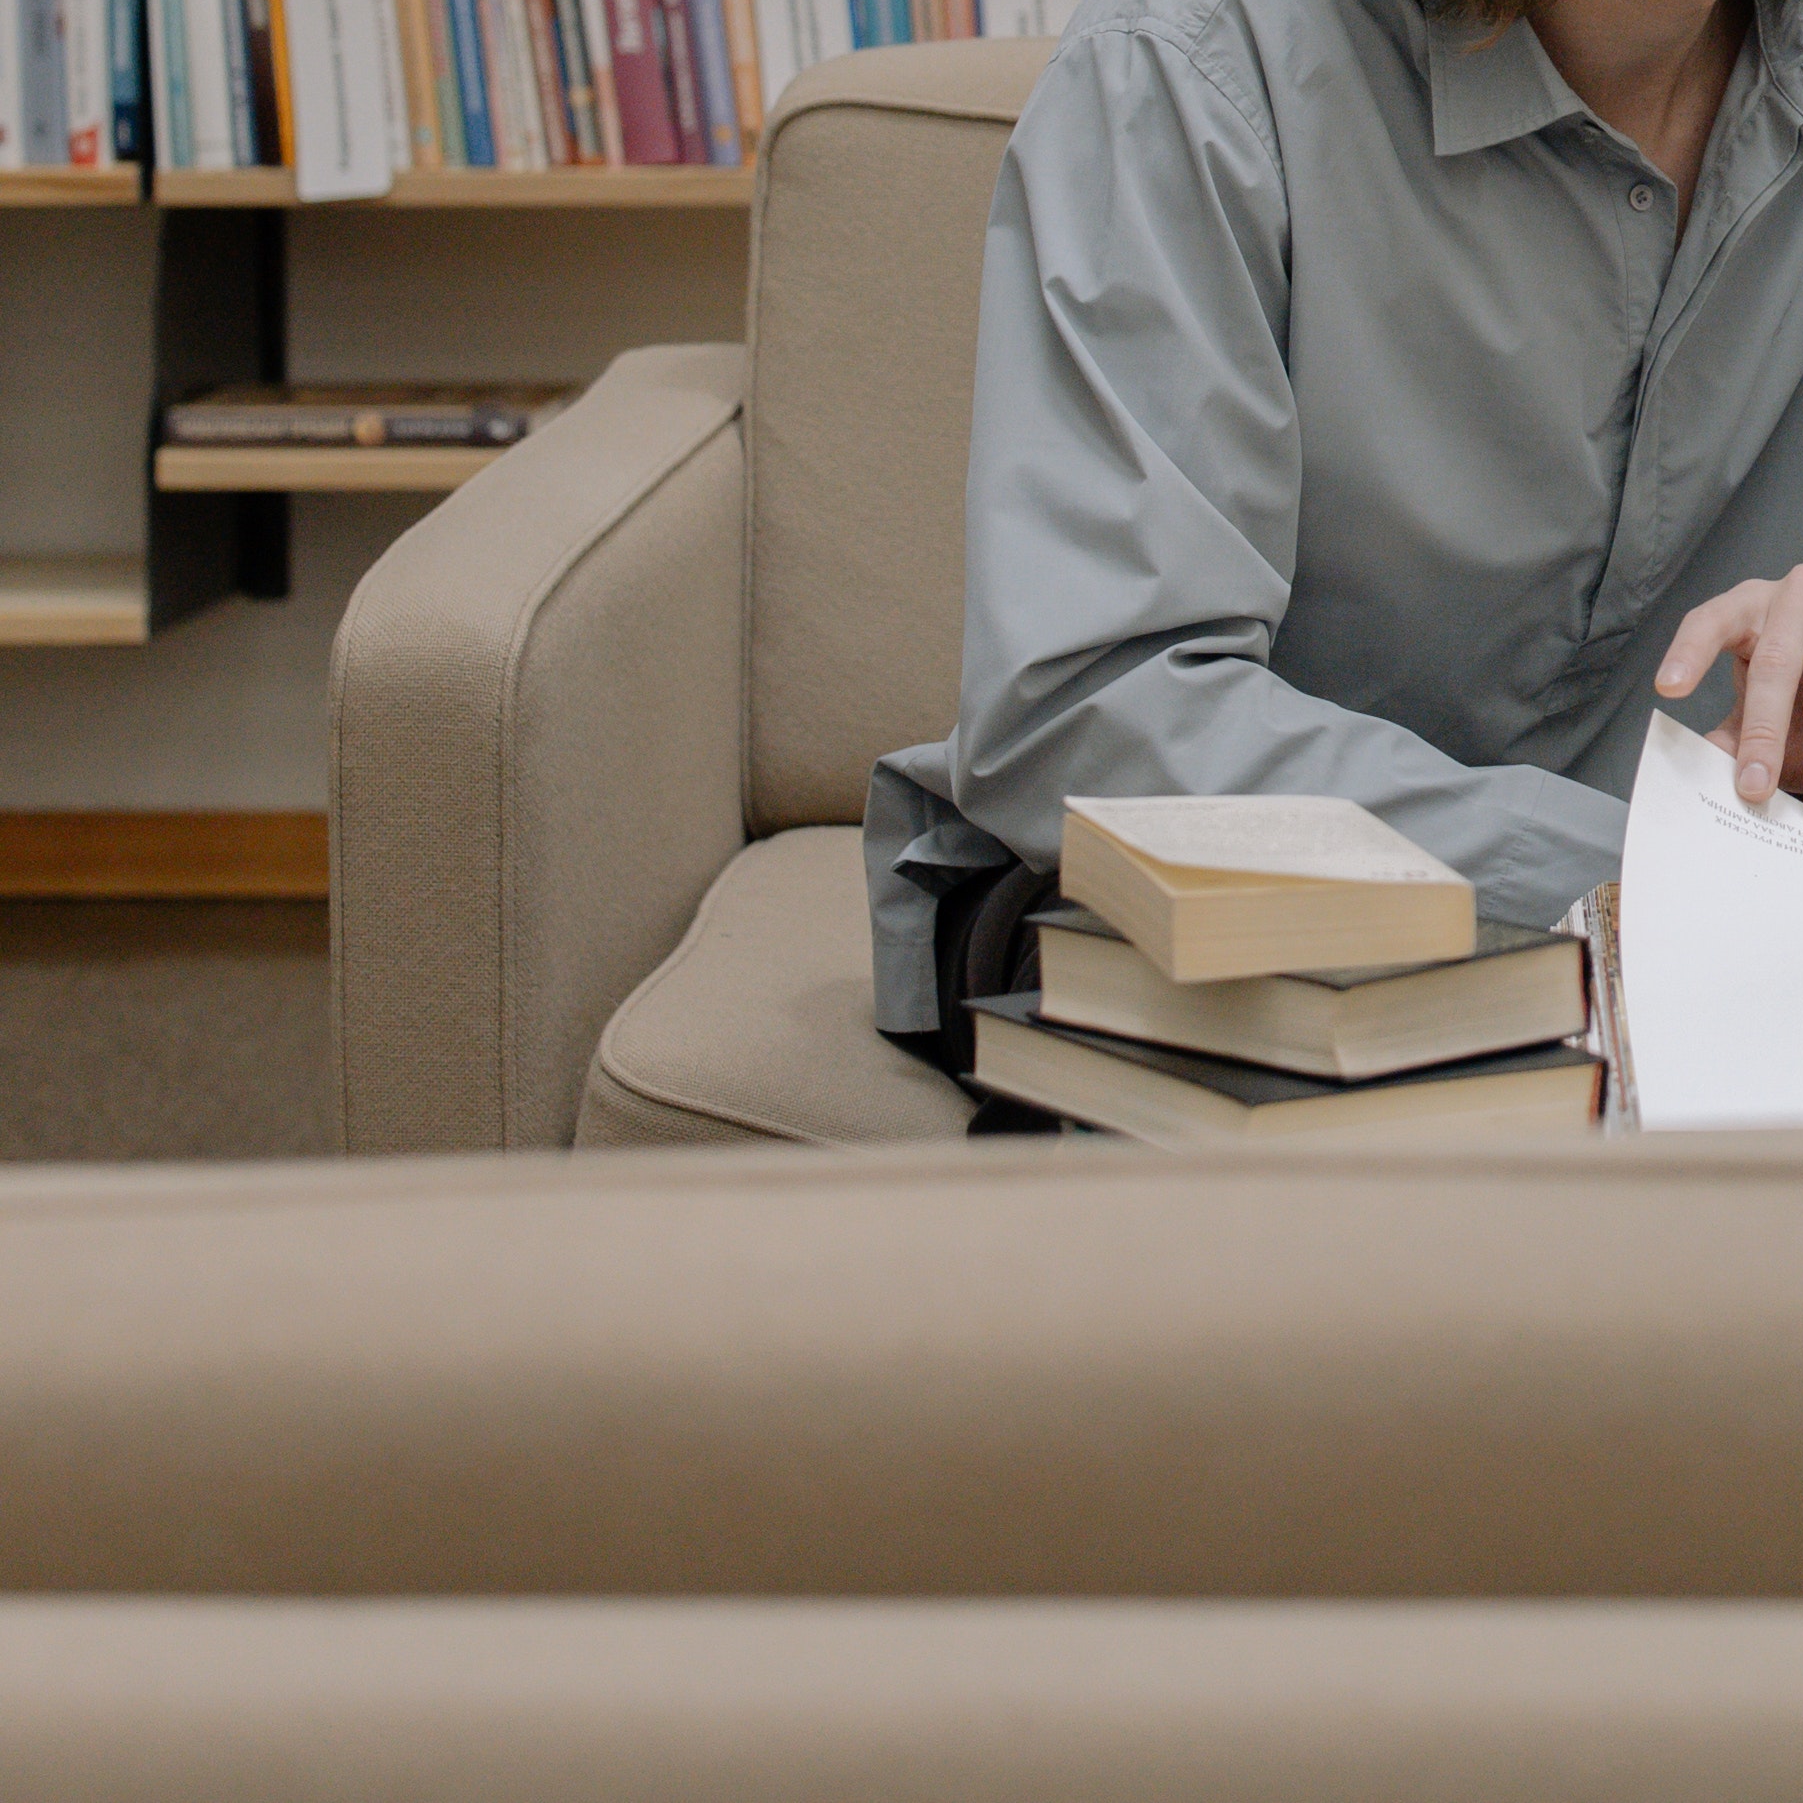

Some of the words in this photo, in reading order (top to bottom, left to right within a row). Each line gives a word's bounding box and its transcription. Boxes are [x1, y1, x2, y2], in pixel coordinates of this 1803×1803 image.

[1714, 814, 1774, 846] РУССКИХ
[1745, 805, 1796, 834] ДВОРЕЦ
[1752, 820, 1776, 837] ЗАЛ
